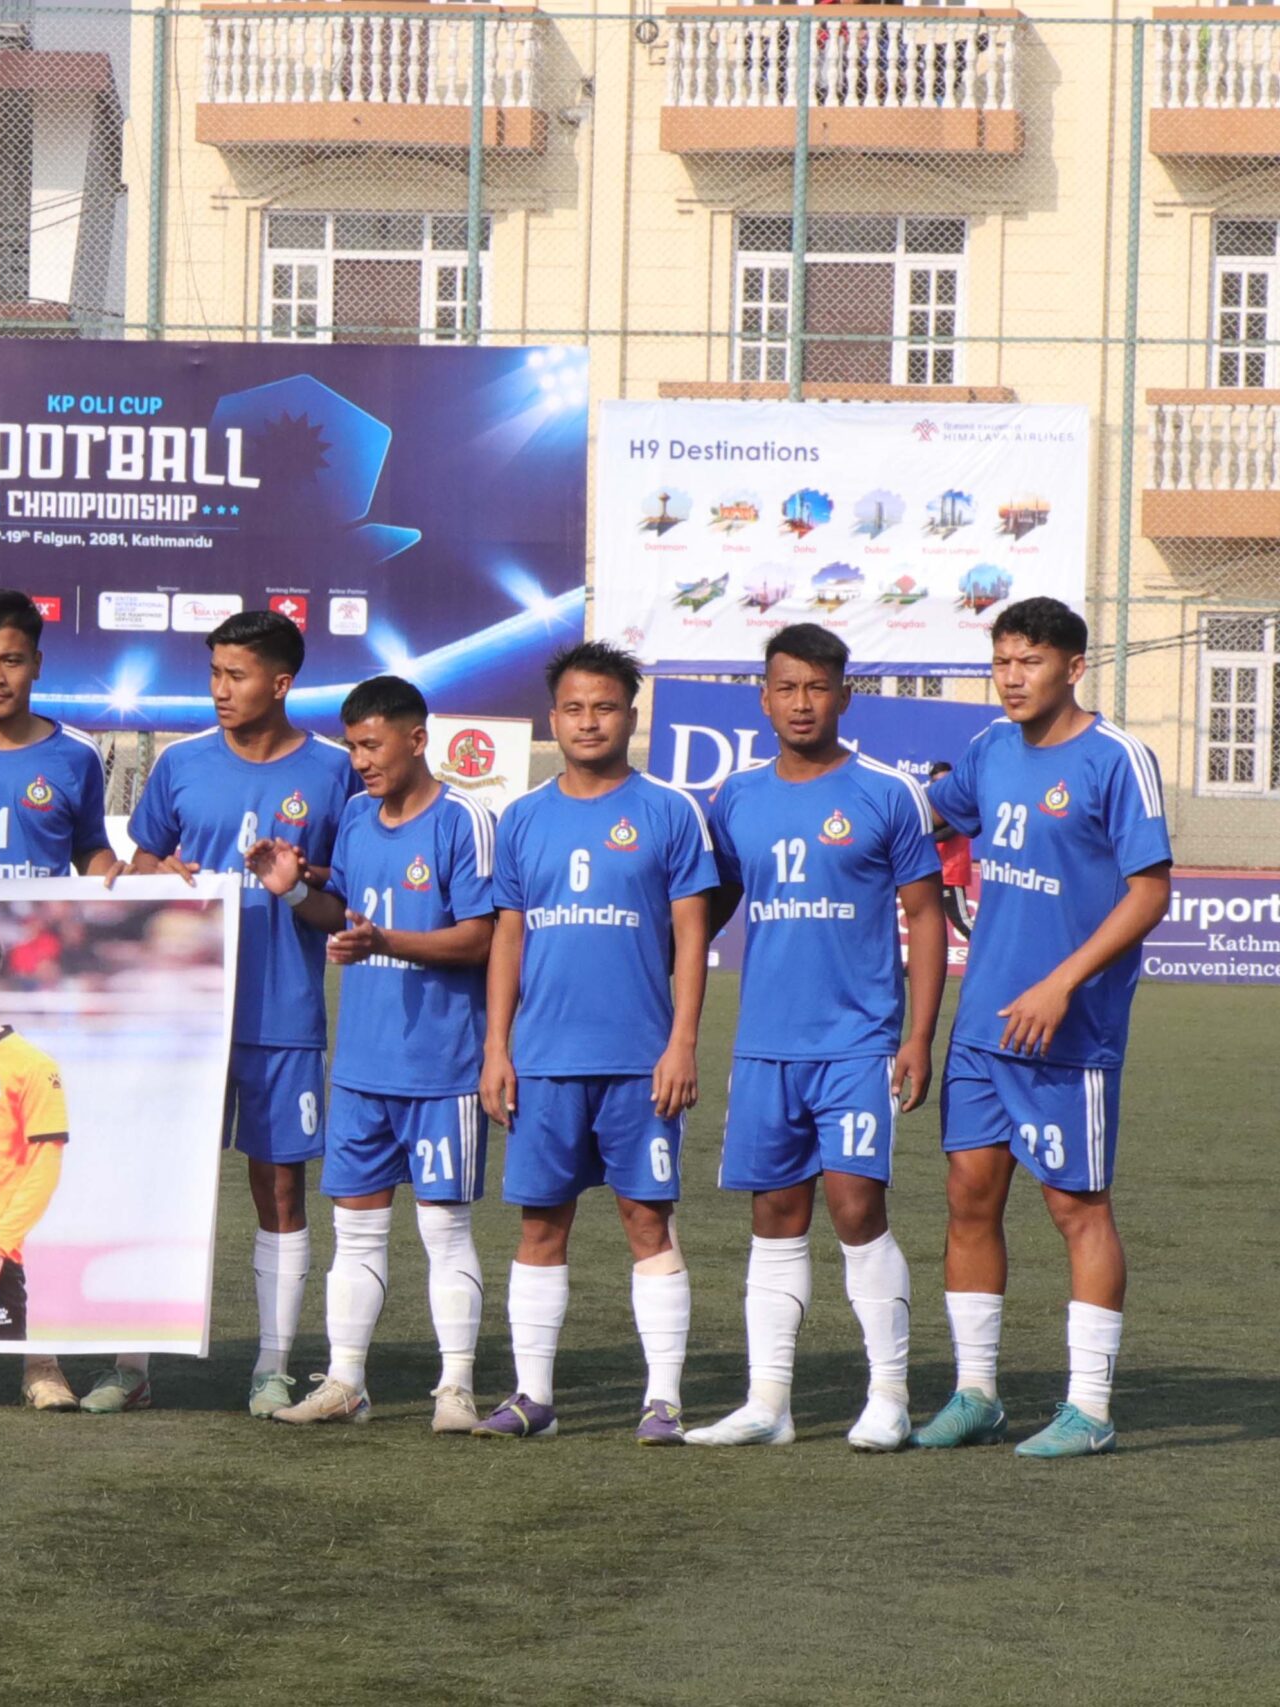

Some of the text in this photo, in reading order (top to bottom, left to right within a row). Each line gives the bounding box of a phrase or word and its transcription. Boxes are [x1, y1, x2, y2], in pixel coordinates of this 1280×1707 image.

[47, 394, 163, 415] KP OLI CUP
[630, 439, 820, 462] H9 Destinations
[7, 490, 198, 521] CHAMPIONSHIP
[33, 530, 86, 547] Falgun,
[89, 532, 128, 547] 2081,
[132, 533, 213, 548] Kathmandu
[958, 620, 993, 631] Chong
[237, 811, 258, 854] 8
[992, 801, 1028, 850] 23
[570, 849, 591, 893] 6
[771, 838, 807, 884] 12
[363, 887, 393, 930] 21
[526, 904, 640, 930] Mahindra
[749, 897, 855, 923] Mahindra
[1163, 891, 1280, 930] irport
[1208, 933, 1280, 952] Kathm
[299, 1091, 318, 1137] 8
[839, 1112, 878, 1157] 12
[416, 1136, 455, 1185] 21
[649, 1137, 672, 1183] 6
[1019, 1123, 1065, 1170] 23
